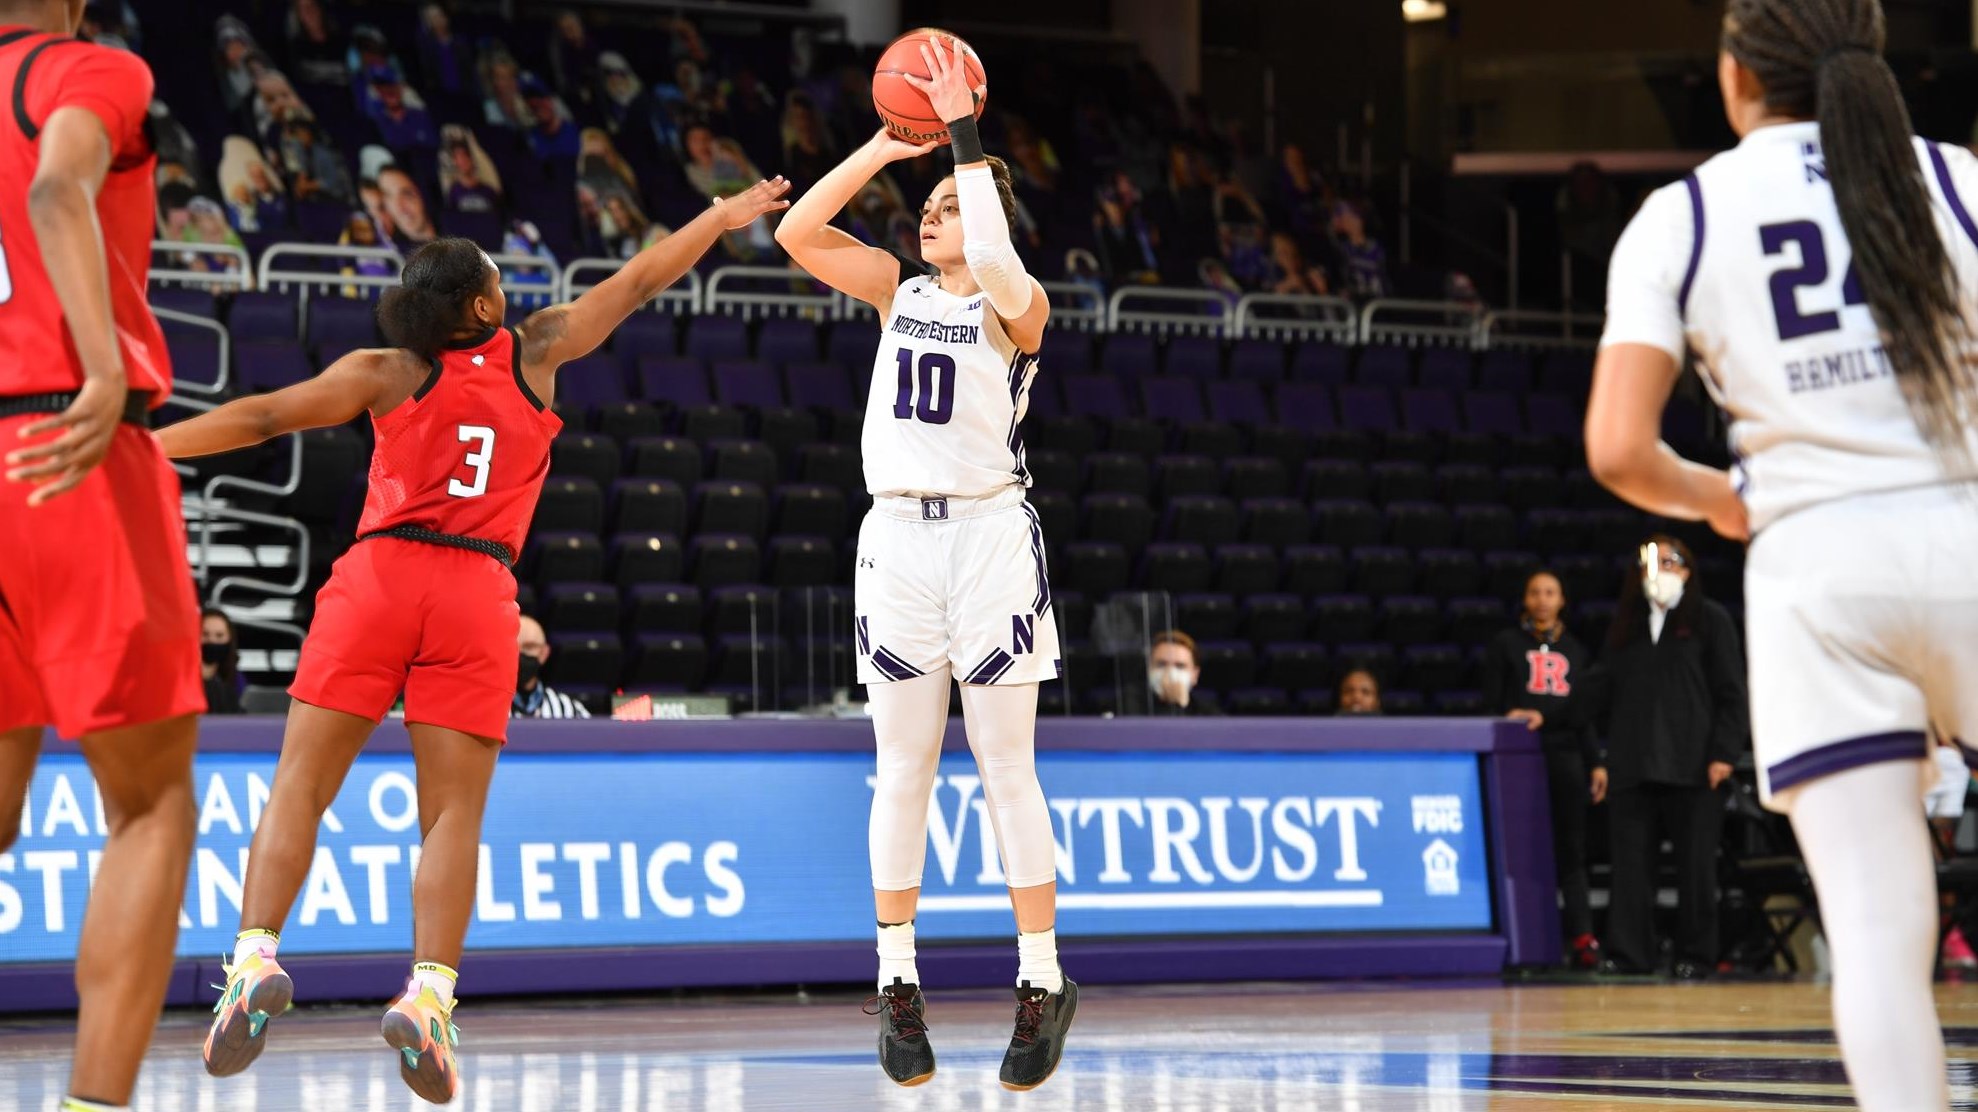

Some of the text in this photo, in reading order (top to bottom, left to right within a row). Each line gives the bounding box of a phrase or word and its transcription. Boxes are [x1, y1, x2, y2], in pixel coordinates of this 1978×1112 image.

[893, 347, 956, 425] 10
[1784, 347, 1893, 393] HAMILT
[447, 425, 496, 498] 3
[928, 502, 941, 518] N
[856, 615, 871, 655] N
[1012, 614, 1034, 654] N
[1526, 651, 1571, 696] R
[297, 840, 746, 926] ATLETICS
